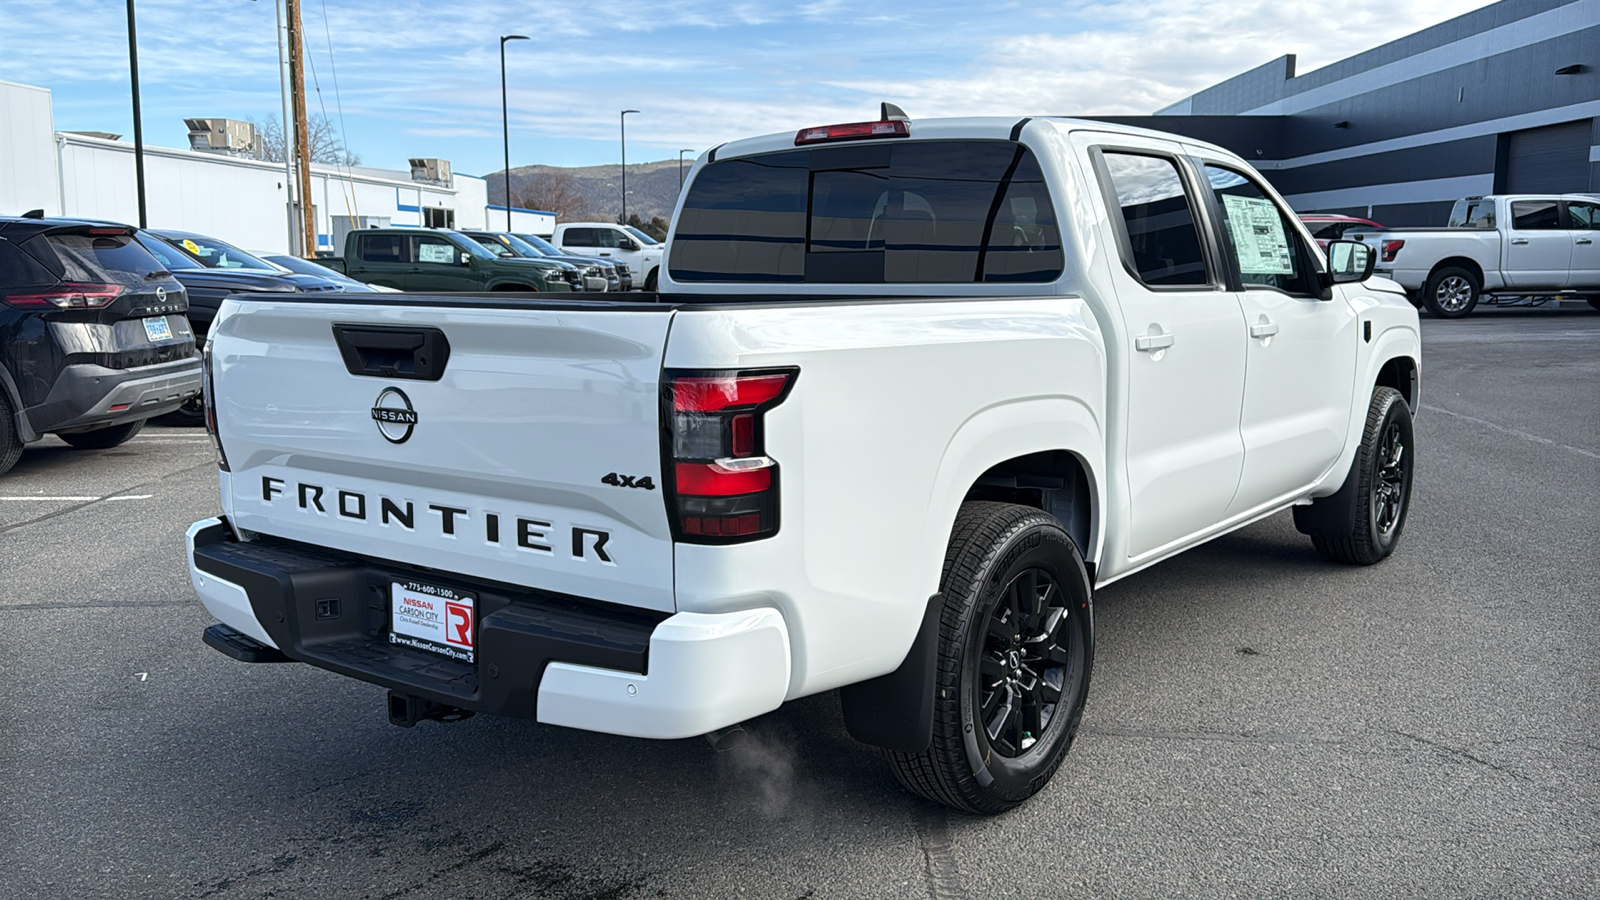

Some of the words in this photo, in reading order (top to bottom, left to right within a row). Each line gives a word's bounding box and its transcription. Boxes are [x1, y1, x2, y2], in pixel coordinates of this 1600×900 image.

[372, 409, 415, 422] NISSAN
[262, 476, 615, 563] FRONTIER
[408, 582, 453, 598] 775-600-1500
[403, 597, 433, 610] NISSAN
[399, 605, 425, 618] CARSON
[425, 611, 439, 621] CITY
[448, 606, 471, 646] R
[396, 637, 468, 660] www.NissanCarsonCity.com
